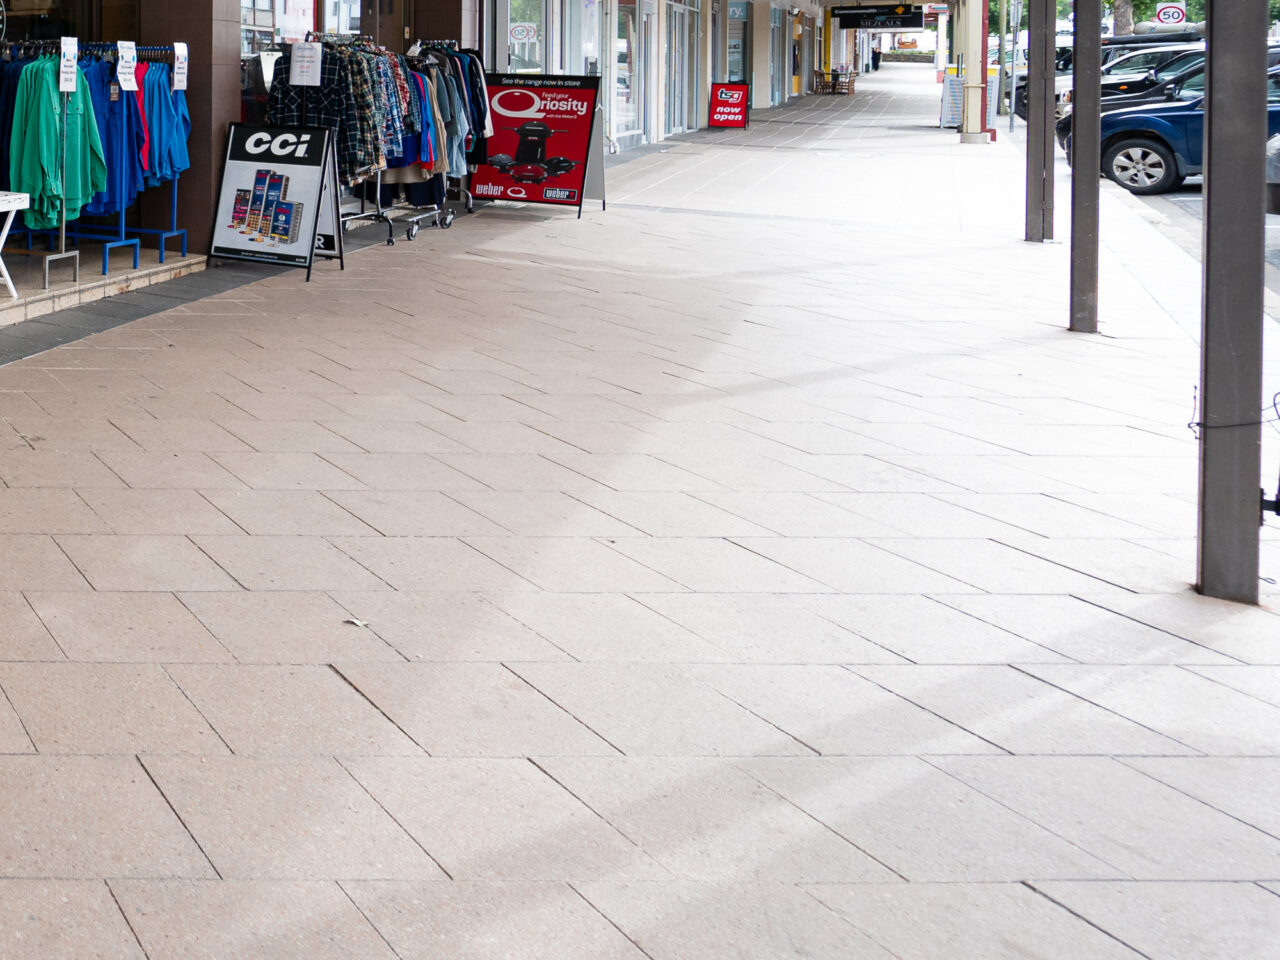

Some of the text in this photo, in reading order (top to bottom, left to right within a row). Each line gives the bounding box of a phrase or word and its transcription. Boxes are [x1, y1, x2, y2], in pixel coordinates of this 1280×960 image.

[1162, 10, 1181, 20] 50
[501, 77, 513, 85] See
[524, 79, 542, 87] range
[713, 113, 743, 122] open
[475, 183, 504, 196] weber
[546, 189, 569, 199] weber
